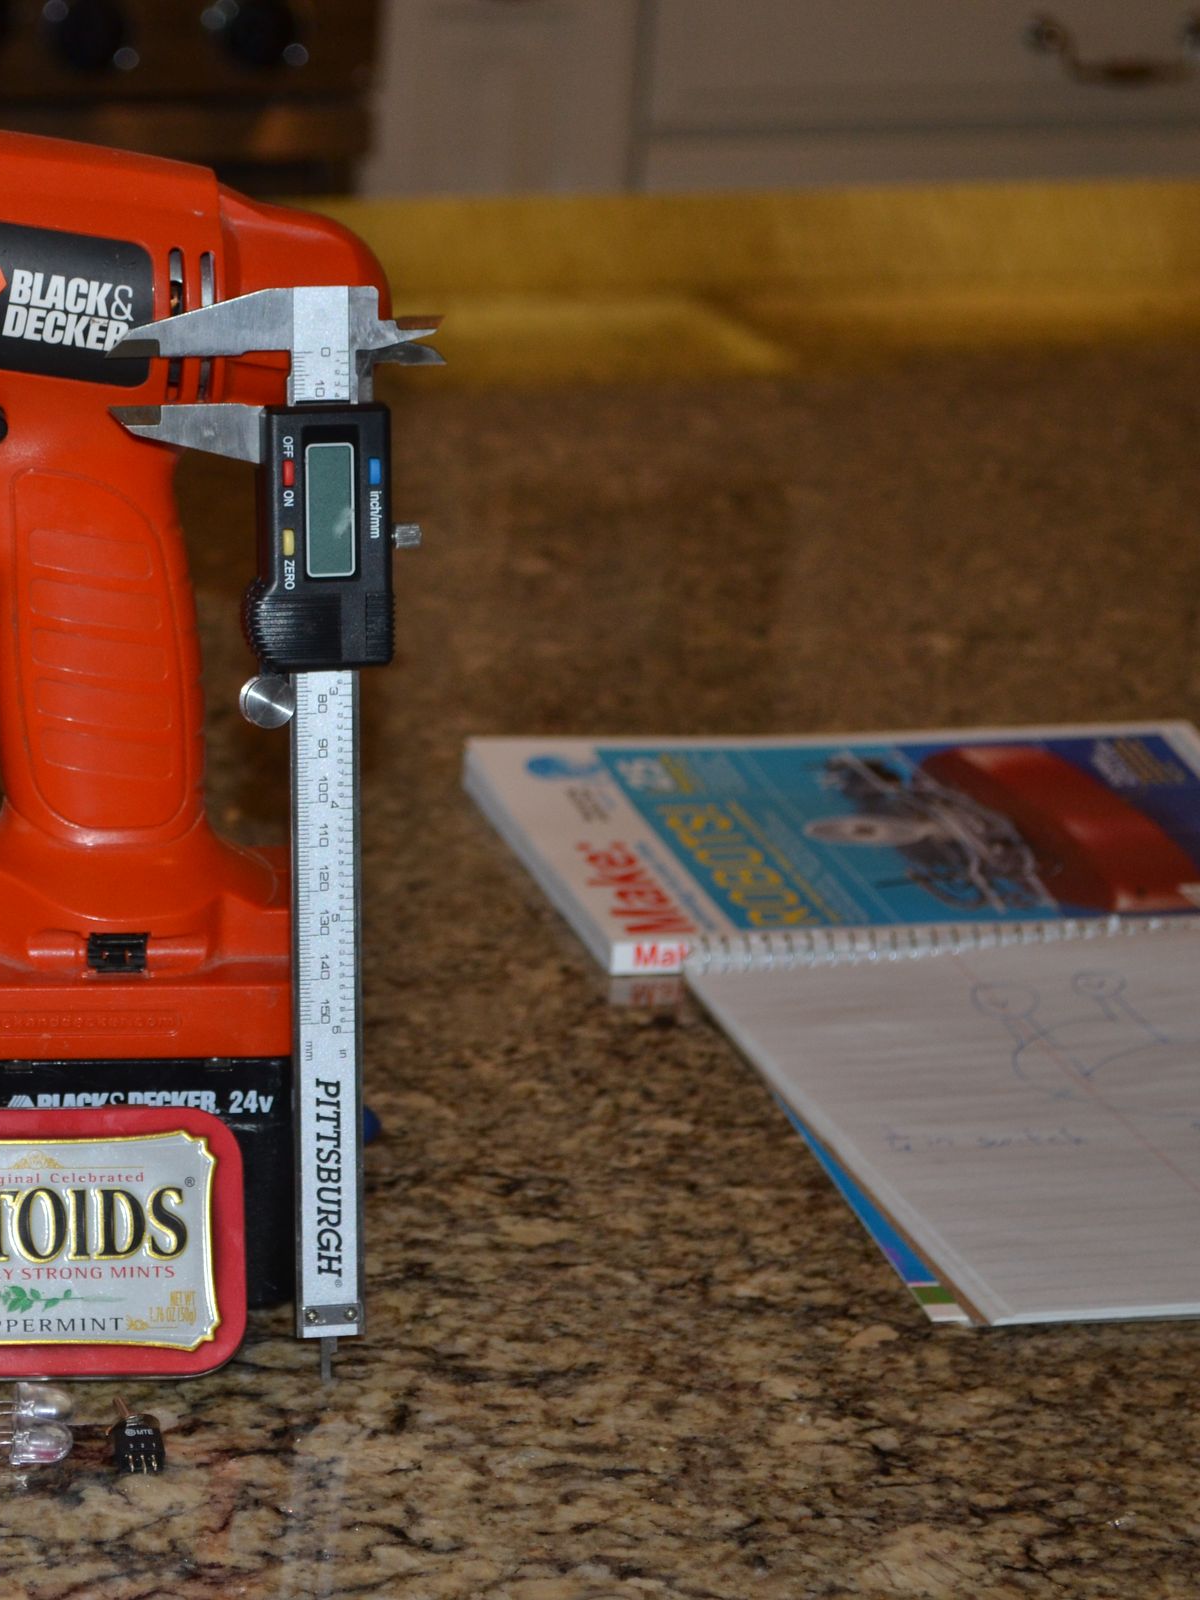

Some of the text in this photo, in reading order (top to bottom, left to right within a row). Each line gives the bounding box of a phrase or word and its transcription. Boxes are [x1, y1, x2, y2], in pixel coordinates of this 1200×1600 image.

[1, 304, 130, 352] DECKER
[282, 436, 294, 458] OFF
[283, 490, 295, 507] ON
[370, 490, 385, 539] inch/mm
[284, 559, 296, 590] ZERO
[317, 694, 328, 714] 80
[318, 738, 329, 758] 90
[318, 776, 329, 803] 100
[330, 800, 340, 809] 4
[319, 824, 329, 848] 110
[319, 865, 330, 892] 120
[319, 909, 330, 936] 130
[320, 954, 330, 980] 140
[320, 1000, 331, 1025] 150
[50, 1171, 145, 1184] Celebrated
[315, 1078, 342, 1278] PITTSBURGH
[21, 1266, 103, 1281] STRONG
[110, 1264, 176, 1279] MINTS
